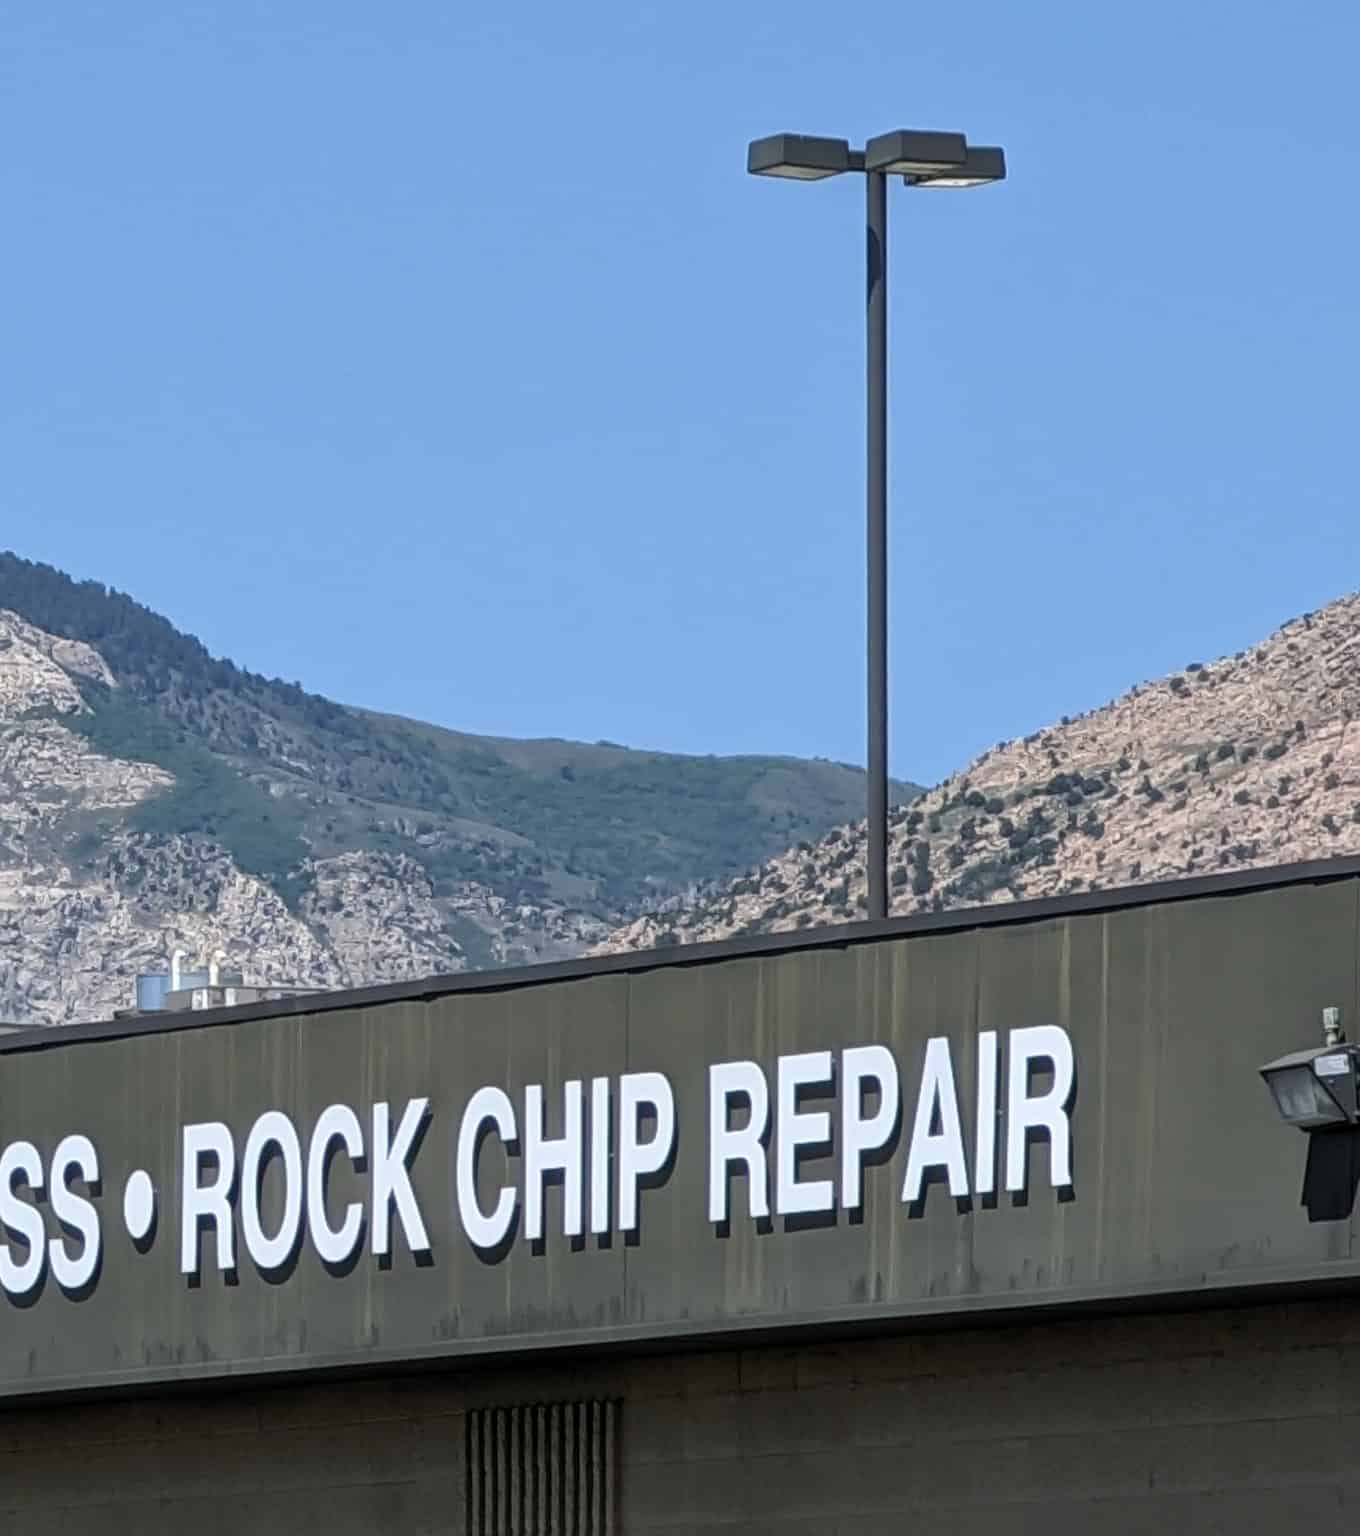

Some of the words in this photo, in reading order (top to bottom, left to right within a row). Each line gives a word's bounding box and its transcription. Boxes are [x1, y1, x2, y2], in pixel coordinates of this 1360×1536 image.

[181, 1097, 430, 1273] ROCK
[456, 1072, 674, 1248] CHIP
[709, 1024, 1074, 1222] REPAIR
